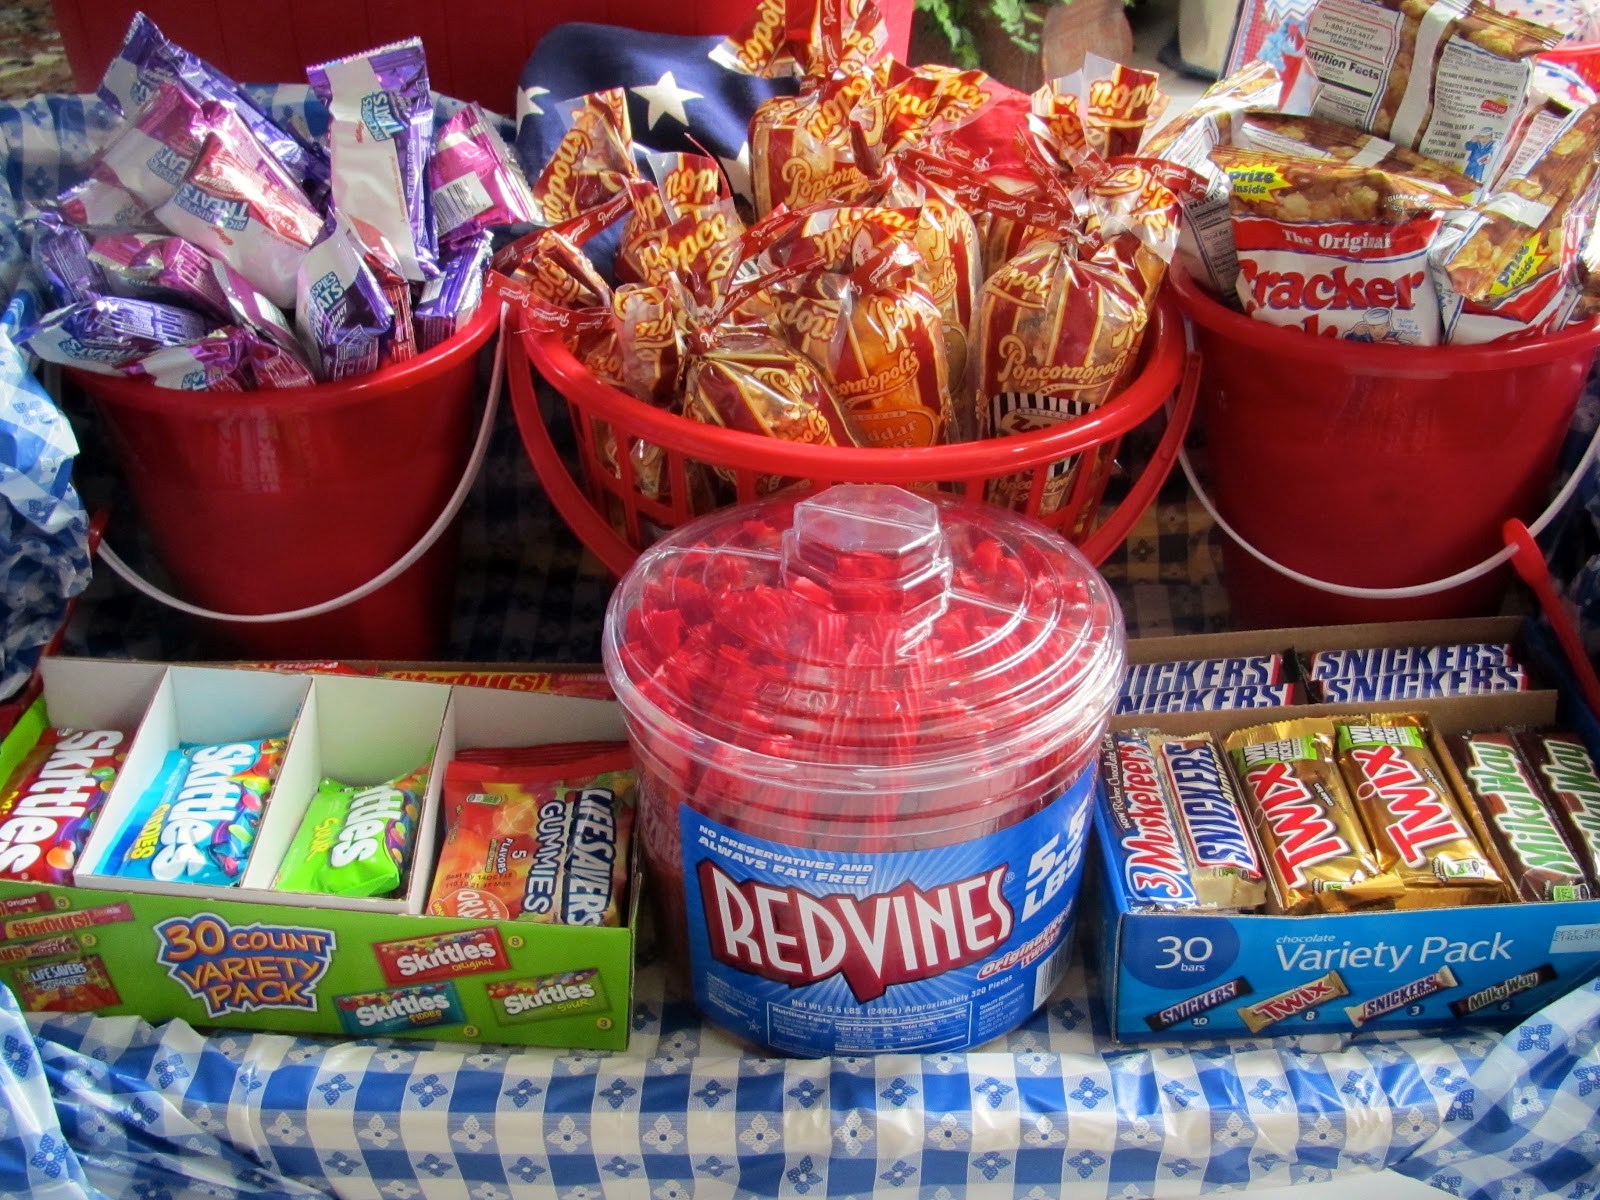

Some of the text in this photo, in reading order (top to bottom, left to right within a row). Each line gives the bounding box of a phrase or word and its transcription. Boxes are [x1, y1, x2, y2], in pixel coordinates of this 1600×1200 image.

[1349, 62, 1380, 80] Facts
[1282, 229, 1313, 246] The
[1318, 231, 1392, 252] Original
[1317, 643, 1506, 681] SNICKERS
[1114, 684, 1284, 716] NICKERS
[1327, 663, 1522, 703] SNICKERS
[152, 743, 256, 882] Skittles
[1165, 743, 1256, 869] SNICKERS
[1352, 744, 1467, 868] TWIX
[1247, 762, 1351, 888] TWIX
[496, 837, 514, 875] FLAVORS
[511, 849, 527, 859] 5
[523, 801, 565, 913] GUMMIES
[698, 835, 870, 885] ALWAYS FAT FREE
[699, 824, 874, 872] NO PRESERVATIVES AND
[6, 896, 38, 908] Original
[1132, 871, 1184, 898] 3
[164, 919, 328, 963] 30 COUNT
[510, 937, 521, 947] 8
[1154, 935, 1213, 969] 30
[1275, 932, 1513, 973] Variety Pack
[1276, 933, 1336, 944] chocolate
[178, 955, 321, 990] VARIETY
[396, 941, 497, 977] Skittles
[1180, 960, 1206, 973] bars
[208, 979, 309, 1010] PACK
[355, 992, 450, 1028] Skittles
[503, 981, 596, 1016] Skittles
[791, 998, 807, 1009] Net
[808, 1002, 825, 1012] Wt.
[827, 1005, 842, 1015] 5.5
[842, 1006, 864, 1015] LBS.
[904, 993, 970, 1014] Approximately
[971, 986, 987, 998] 320
[988, 974, 1014, 990] Pieces
[1160, 981, 1237, 1025] SNICKERS
[1365, 975, 1436, 1016] SNICKERS
[1411, 1005, 1420, 1016] 3
[466, 1026, 475, 1036] 3
[599, 1018, 609, 1028] 3
[772, 1006, 831, 1024] Nutrition Facts
[1192, 1016, 1208, 1027] 10
[1305, 1011, 1315, 1021] 8
